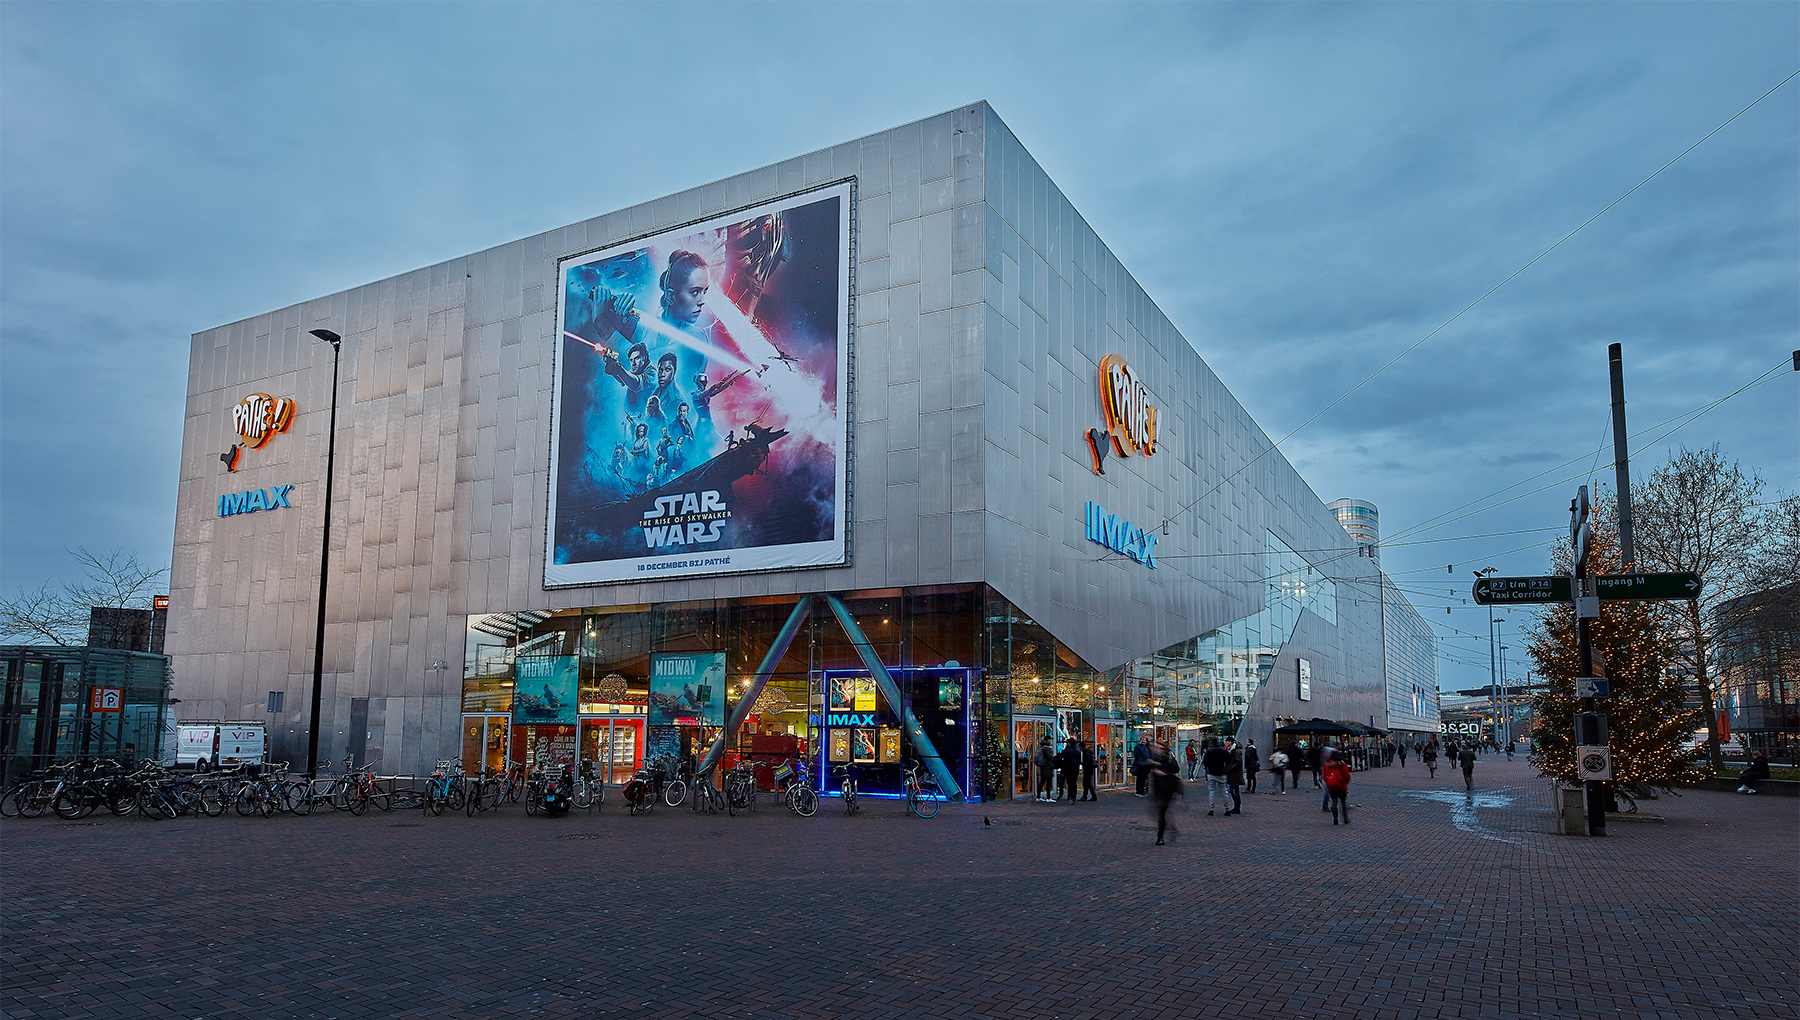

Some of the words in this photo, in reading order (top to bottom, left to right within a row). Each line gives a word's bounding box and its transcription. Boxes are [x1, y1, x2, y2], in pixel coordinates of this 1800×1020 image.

[217, 484, 295, 518] IMAX
[643, 490, 726, 519] STAR
[639, 519, 651, 527] THE
[654, 517, 671, 526] RISE
[687, 510, 732, 523] SKYWALKER
[643, 519, 726, 548] WARS
[1086, 500, 1159, 570] IMAX
[646, 561, 688, 570] DECEMBER
[689, 559, 704, 567] BIJ
[704, 555, 731, 566] PATHÉ
[1531, 580, 1549, 588] P14
[1597, 578, 1633, 587] Ingang
[1636, 576, 1645, 584] M
[1491, 591, 1510, 599] Taxi
[1512, 590, 1552, 599] Corridor
[521, 662, 555, 677] MIDWAY
[655, 660, 697, 676] MIDWAY
[827, 714, 875, 726] IMAX
[189, 730, 210, 743] VIP
[231, 731, 256, 740] VIP
